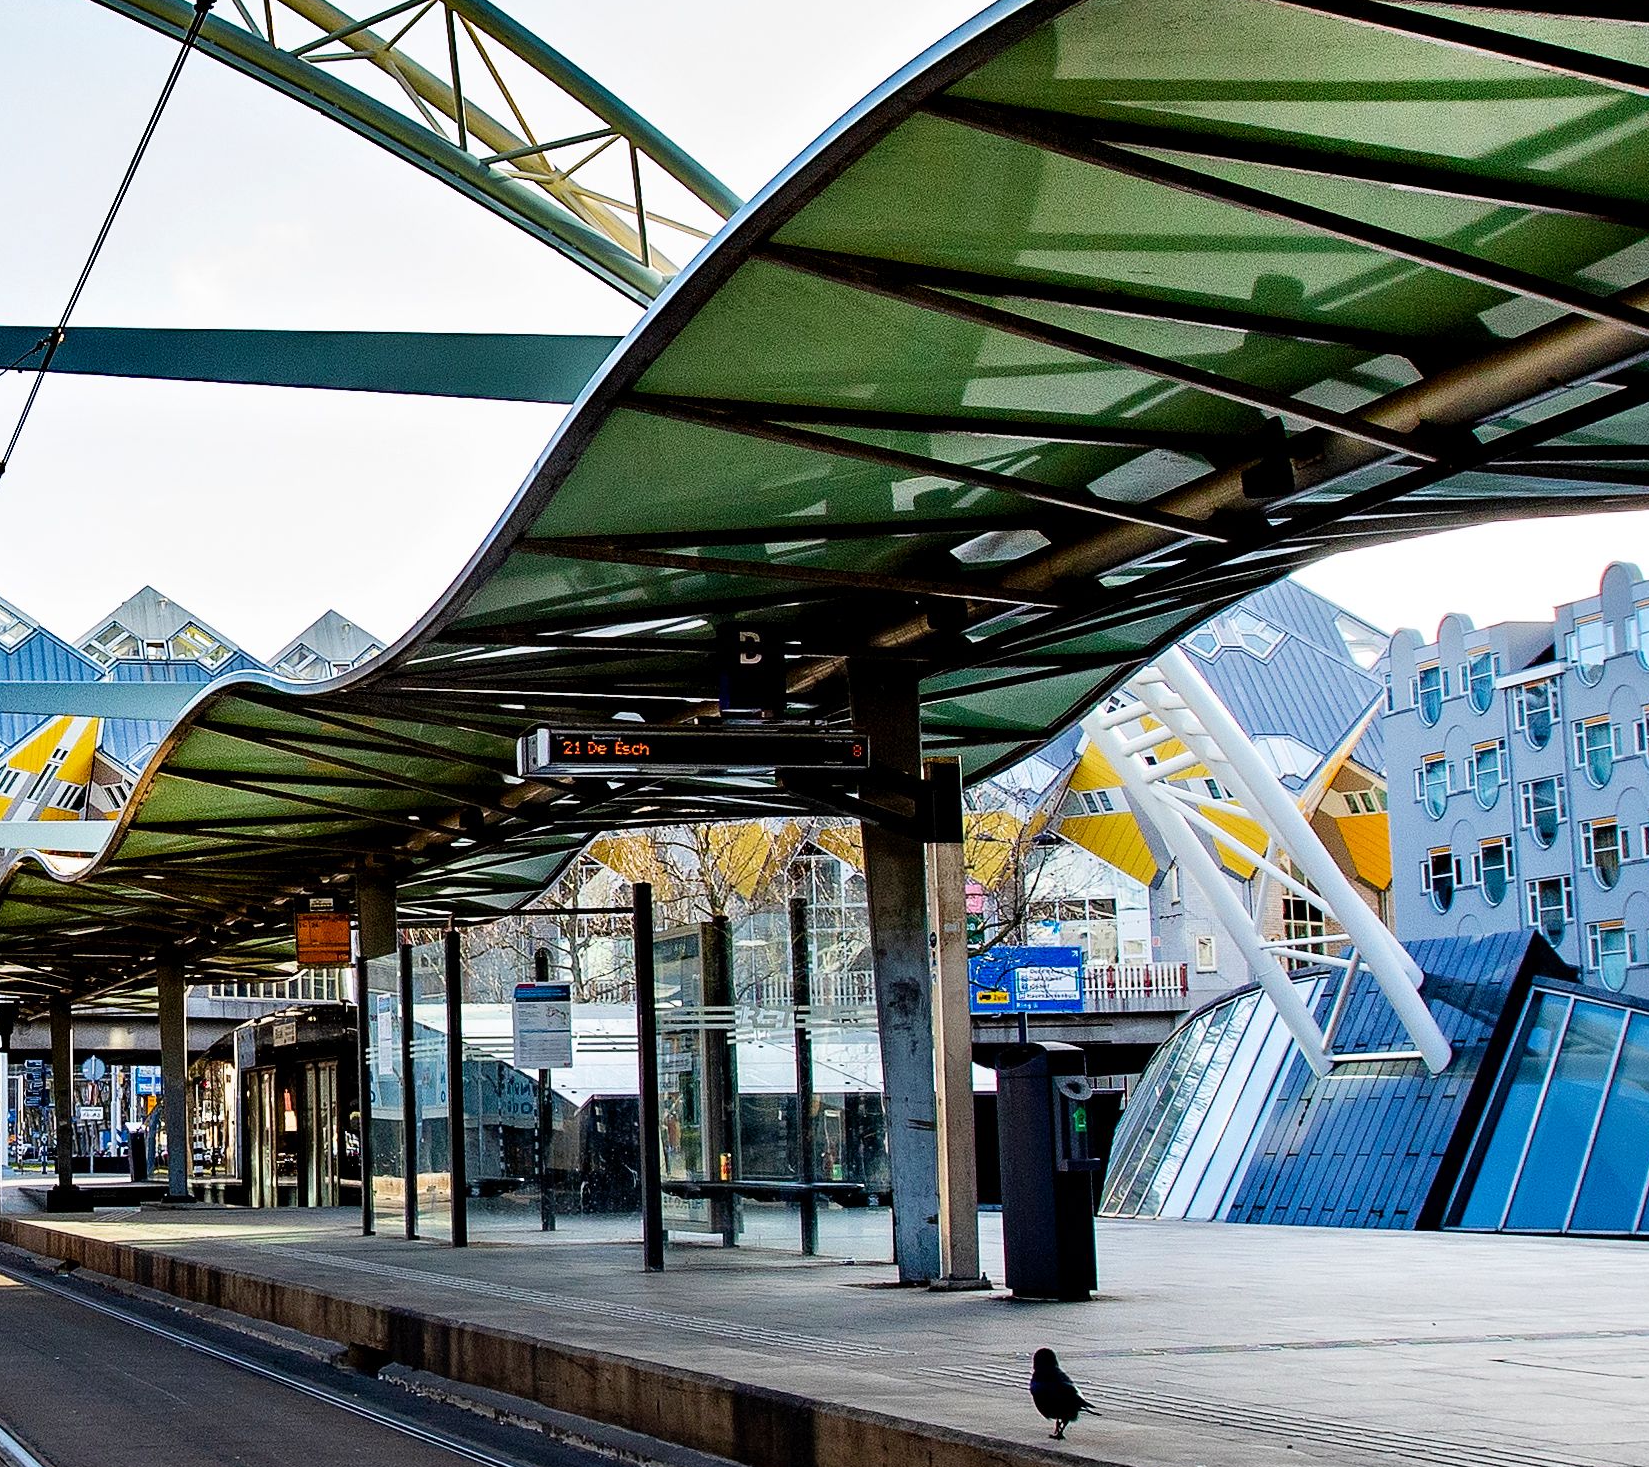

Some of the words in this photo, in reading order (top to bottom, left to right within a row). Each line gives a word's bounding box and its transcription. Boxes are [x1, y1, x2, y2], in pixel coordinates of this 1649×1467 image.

[563, 741, 581, 755] 21
[587, 741, 608, 755] De
[614, 741, 650, 755] Esch
[853, 744, 862, 757] 8
